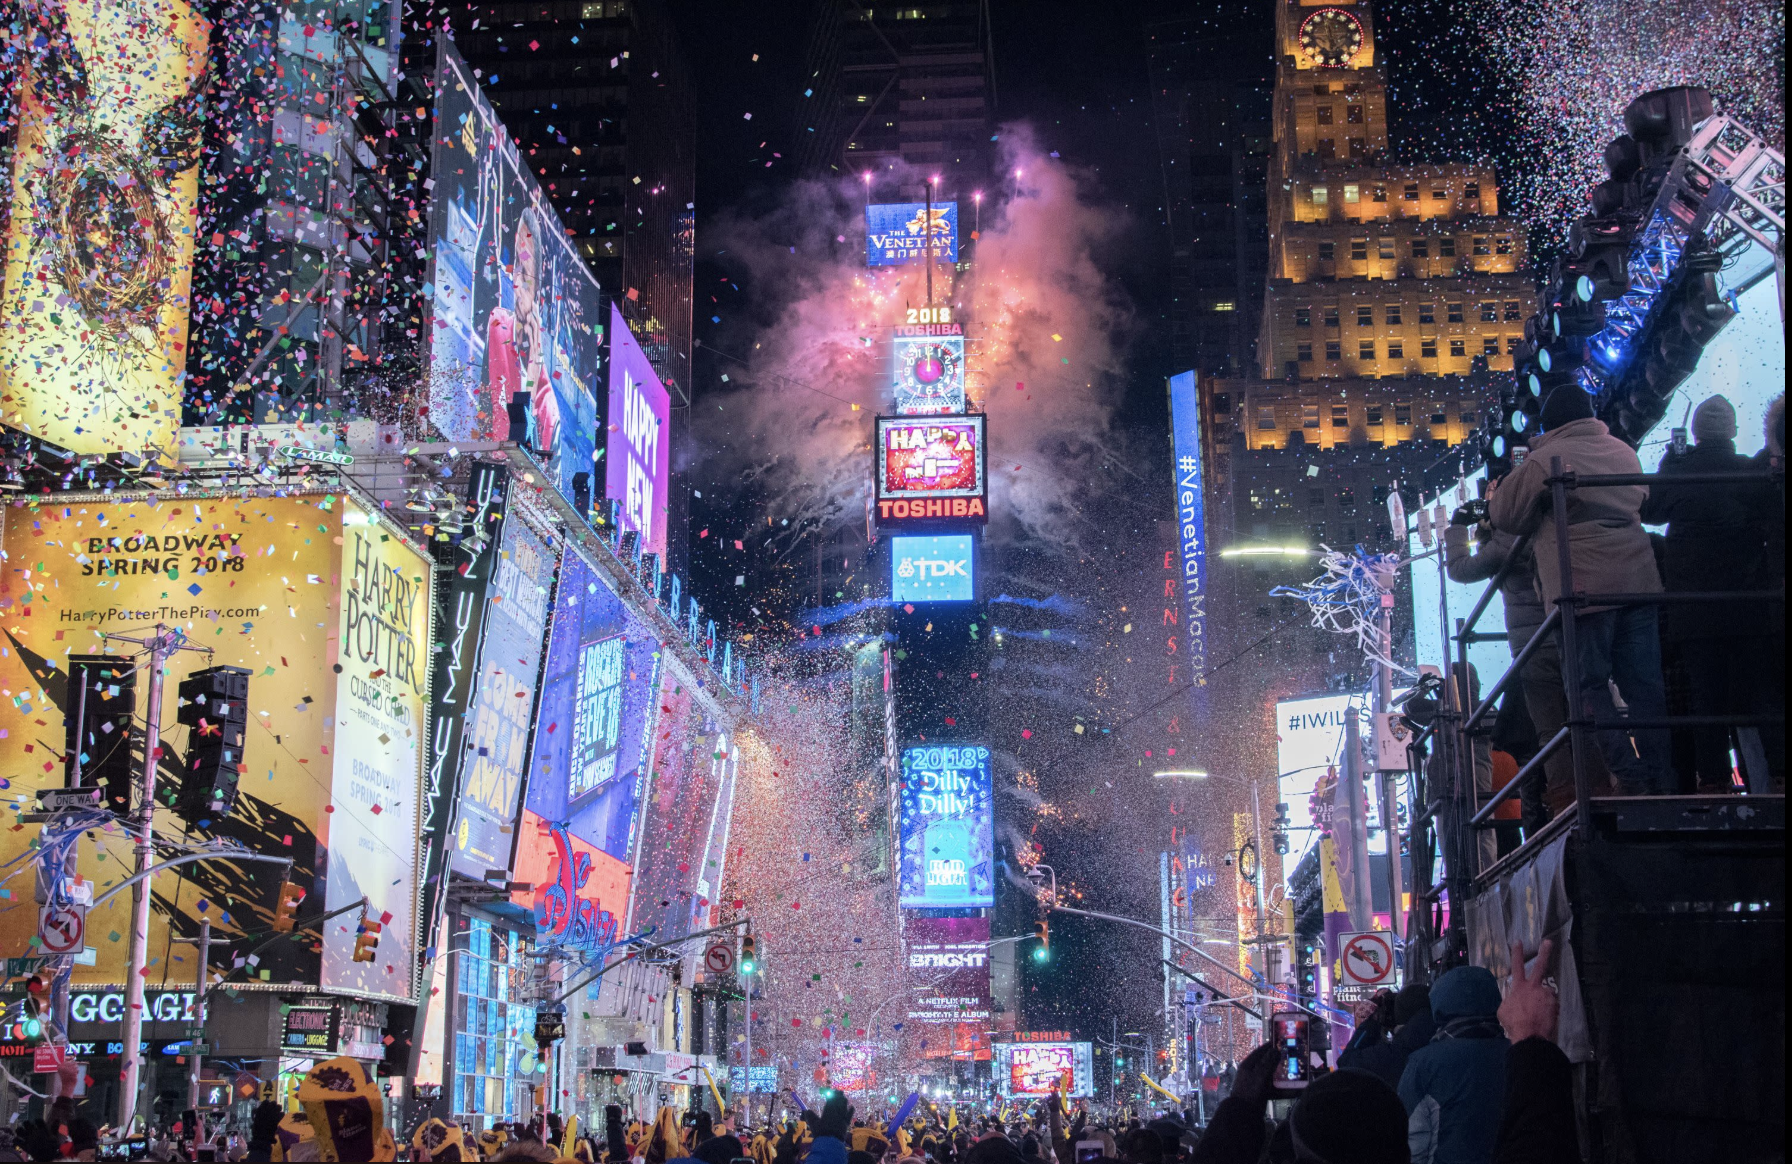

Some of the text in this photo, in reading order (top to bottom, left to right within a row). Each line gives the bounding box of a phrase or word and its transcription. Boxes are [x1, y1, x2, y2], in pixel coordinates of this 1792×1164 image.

[869, 234, 952, 249] VENETAN
[906, 307, 950, 324] 2018
[895, 323, 962, 336] TOSHIBA
[925, 385, 933, 395] 6
[623, 368, 659, 477] HAPPY
[626, 450, 653, 543] NEW
[878, 498, 984, 518] TOSHIBA
[88, 533, 242, 554] BROADWAY
[82, 556, 244, 577] SPRING 2018
[913, 559, 967, 577] TDK
[354, 531, 419, 637] HARRY
[344, 589, 420, 696] POTTER
[380, 677, 391, 694] THE
[483, 659, 531, 729] COME
[350, 675, 410, 726] CURSED CHILD
[911, 747, 977, 770] 2018
[352, 758, 401, 796] BROADWAY
[465, 753, 518, 819] AWAY
[920, 770, 971, 797] Dilly
[55, 795, 74, 806] ONE
[350, 781, 381, 808] SPRING
[918, 793, 974, 819] Dilly!
[925, 871, 967, 886] LIGHT
[909, 953, 987, 968] BRIGHT
[960, 997, 979, 1005] FILM
[1014, 1031, 1071, 1042] TOSHIBA
